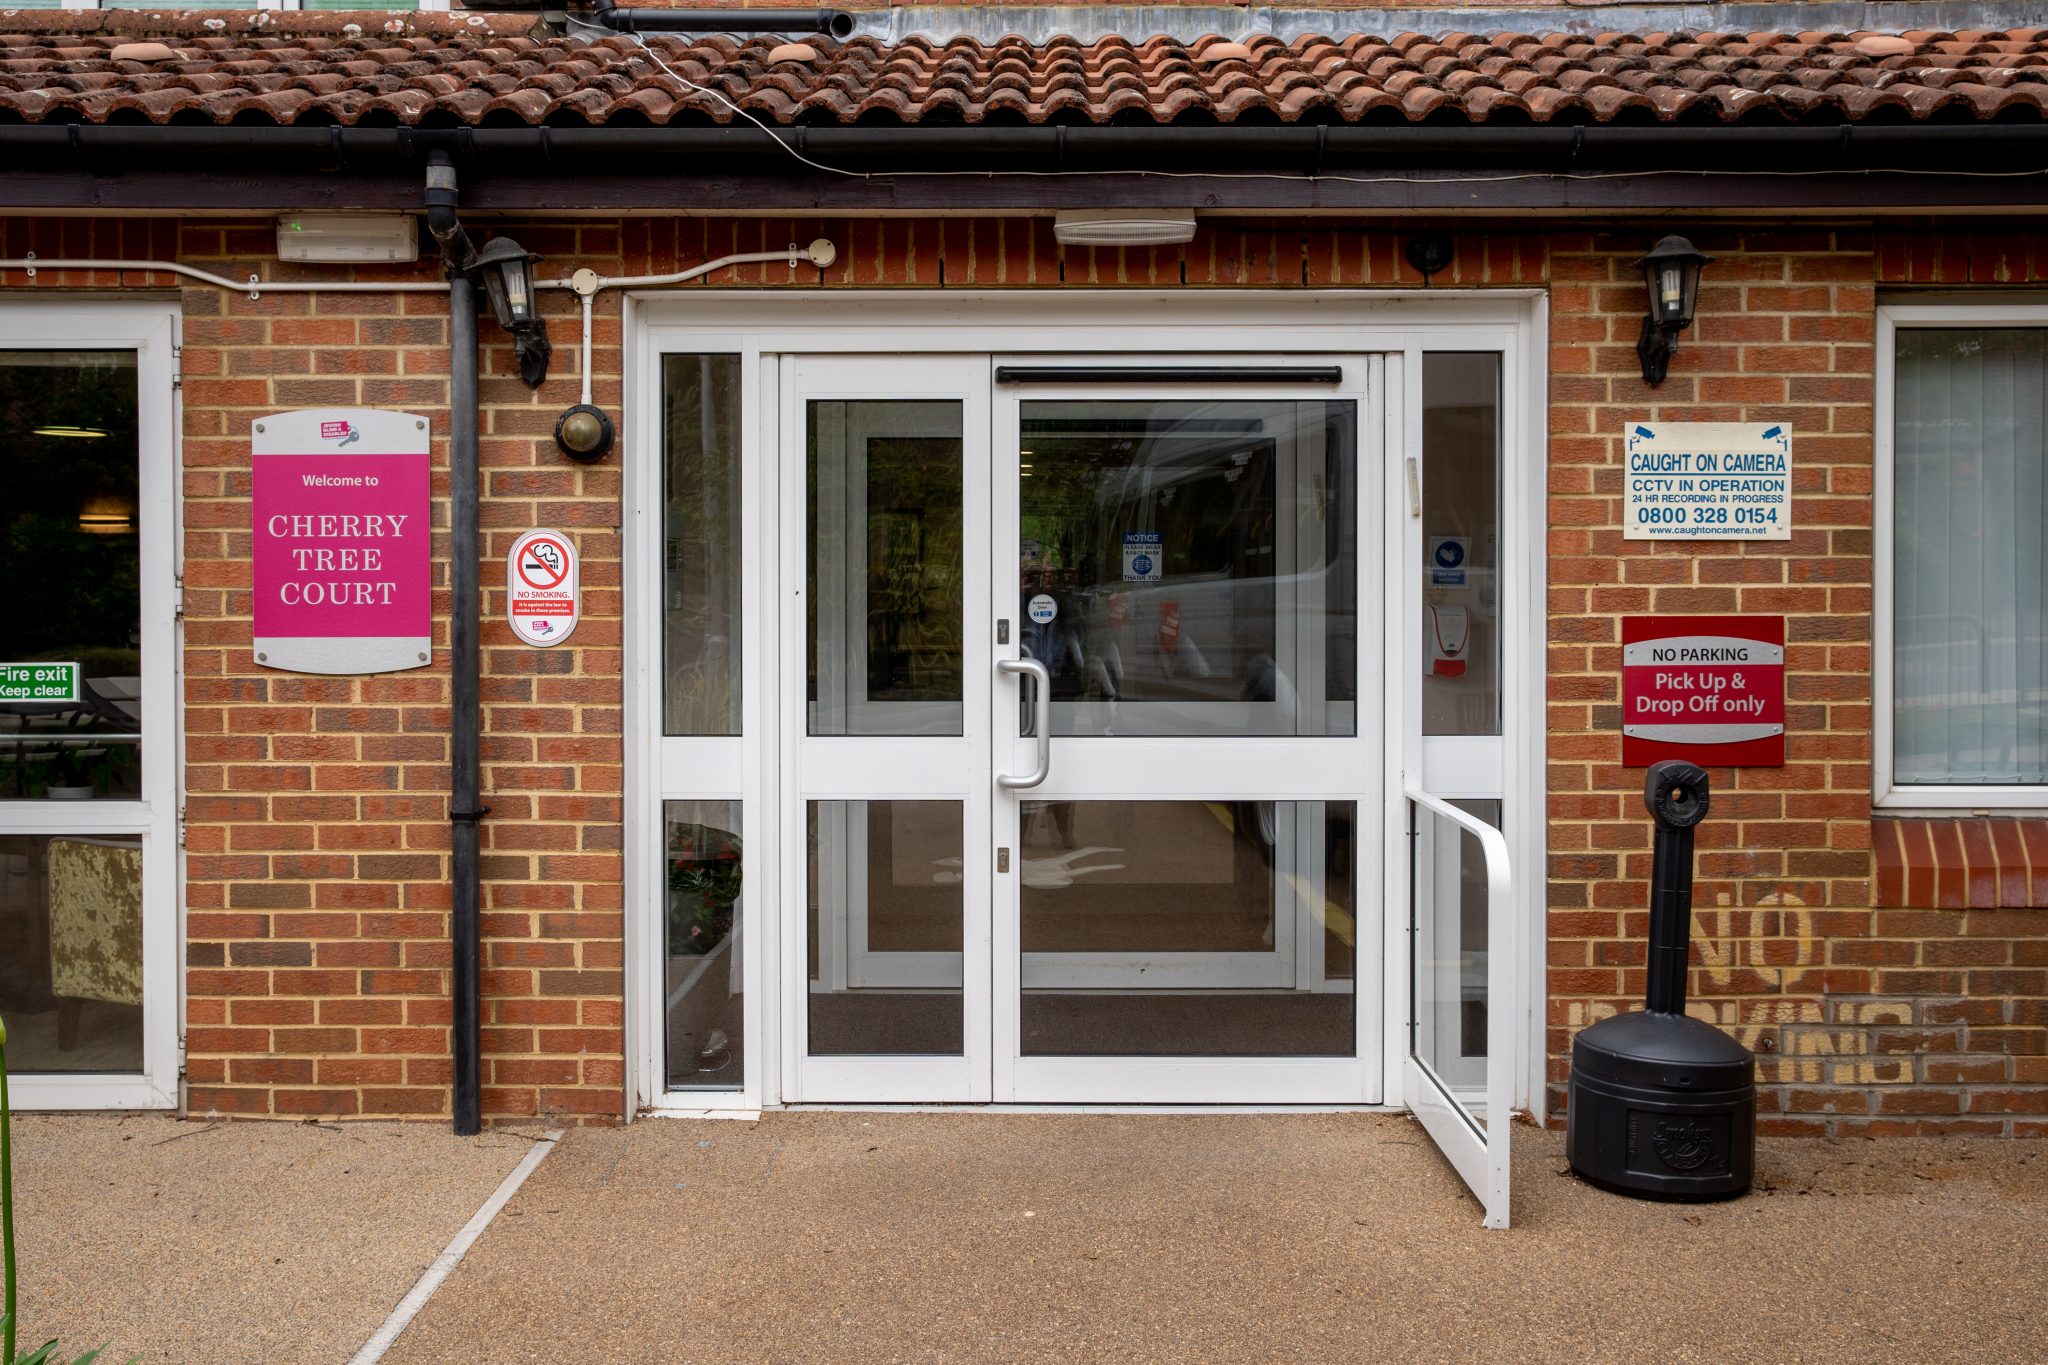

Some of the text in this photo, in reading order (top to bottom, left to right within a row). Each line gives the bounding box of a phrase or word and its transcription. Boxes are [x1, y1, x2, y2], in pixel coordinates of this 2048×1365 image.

[1631, 453, 1786, 472] CAUGHT ON CAMERA
[302, 474, 379, 487] Welcome to
[1632, 479, 1785, 492] CCTV IN OPERATION
[1632, 494, 1784, 503] 24 HR RECORDING IN PROGRESS
[1638, 507, 1777, 524] 0800 328 0154
[268, 514, 409, 538] CHERRY
[1649, 526, 1767, 535] www.caughtoncamera.net
[1126, 534, 1159, 542] NOTICE
[292, 548, 382, 571] TREE
[280, 582, 396, 605] COURT
[1652, 648, 1749, 662] NO PARKING
[34, 666, 68, 682] exit
[34, 684, 68, 696] clear
[1655, 672, 1746, 694] Pick Up &
[1636, 694, 1766, 717] Drop Off only
[1690, 892, 1813, 987] NO
